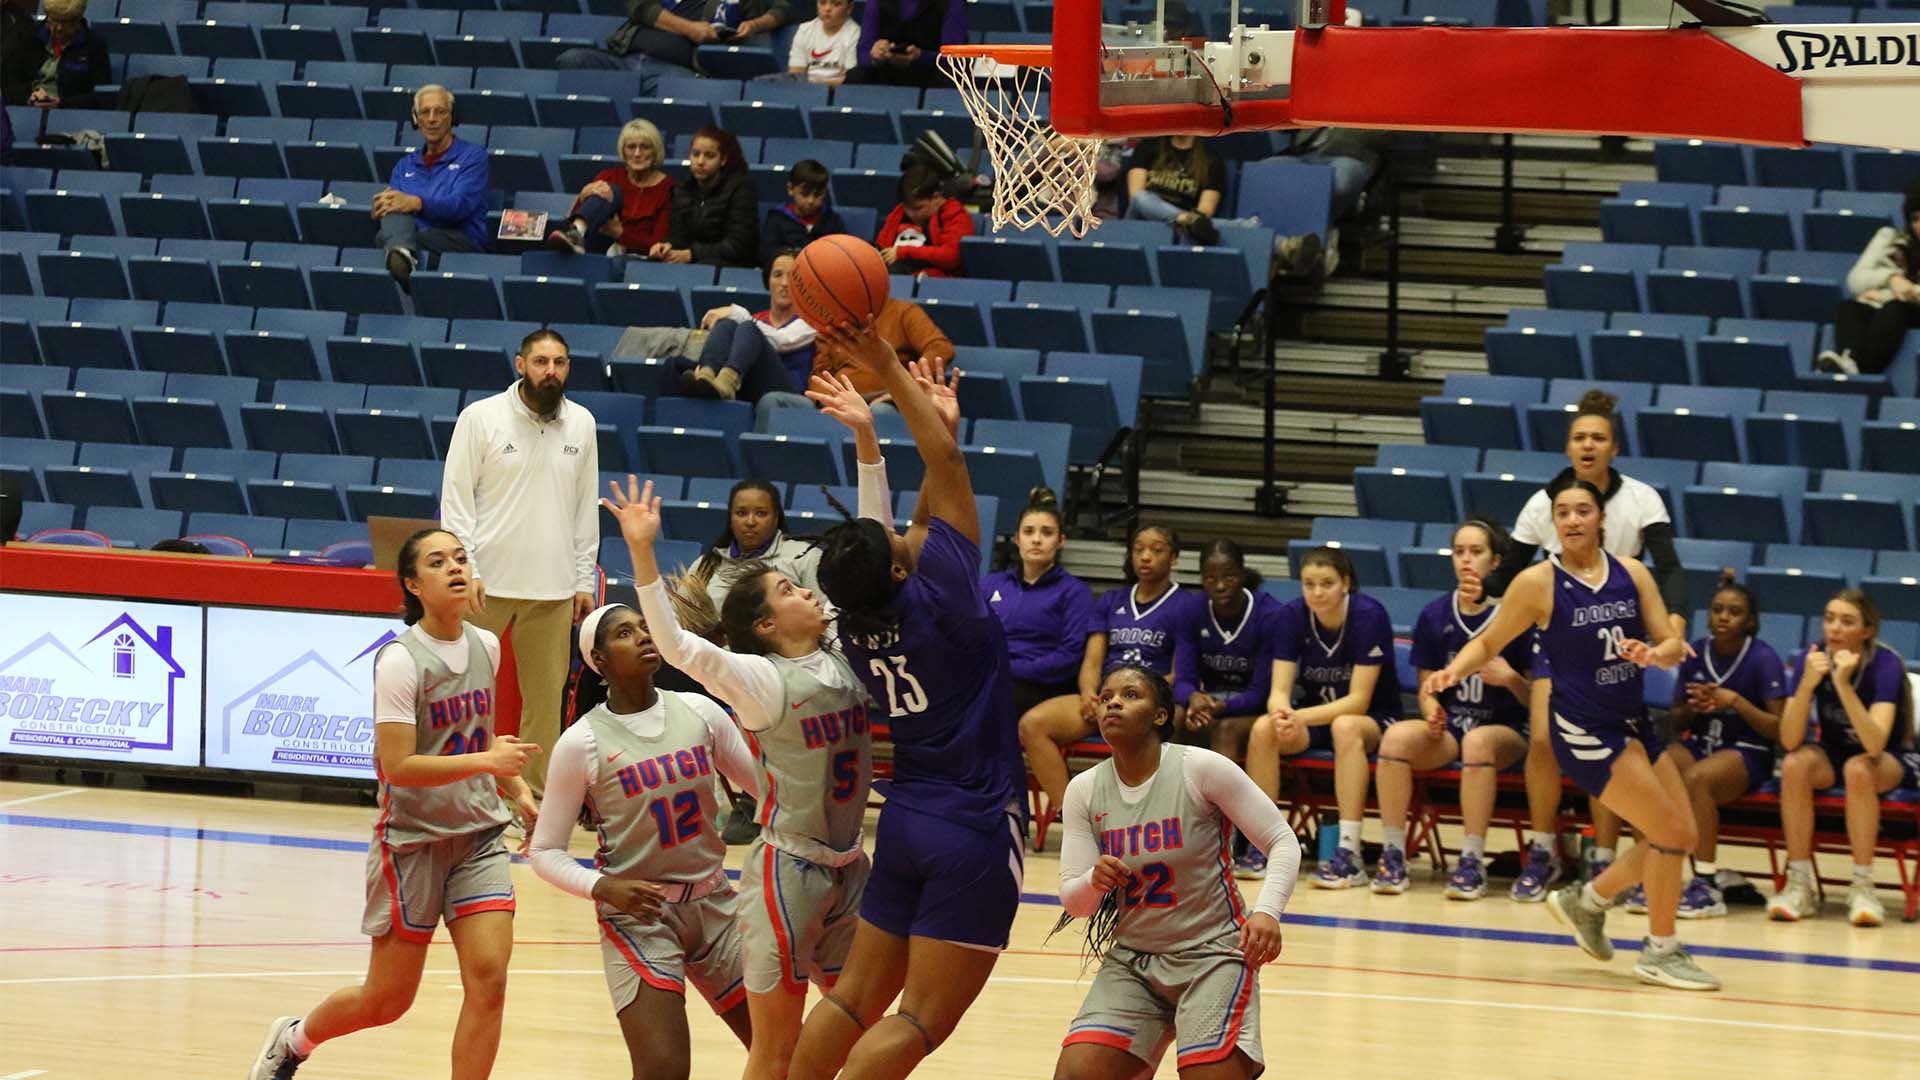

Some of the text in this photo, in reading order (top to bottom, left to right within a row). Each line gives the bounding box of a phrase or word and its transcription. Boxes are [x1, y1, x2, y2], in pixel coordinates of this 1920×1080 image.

[1776, 30, 1920, 73] SPALDI
[1572, 600, 1637, 627] DODGE
[1109, 627, 1166, 647] DODGE
[255, 693, 320, 712] MARK
[869, 655, 928, 717] 23
[14, 733, 66, 744] RESIDENTIAL
[75, 738, 131, 749] COMMERCIAL
[19, 720, 126, 735] CONSTRUCTION
[242, 709, 375, 743] BOREC
[277, 752, 329, 763] RESIDENTIAL
[616, 745, 711, 799] HUTCH
[831, 750, 860, 805] 5
[649, 790, 702, 849] 12
[1100, 816, 1183, 861] HUTCH
[1123, 861, 1177, 908] 22
